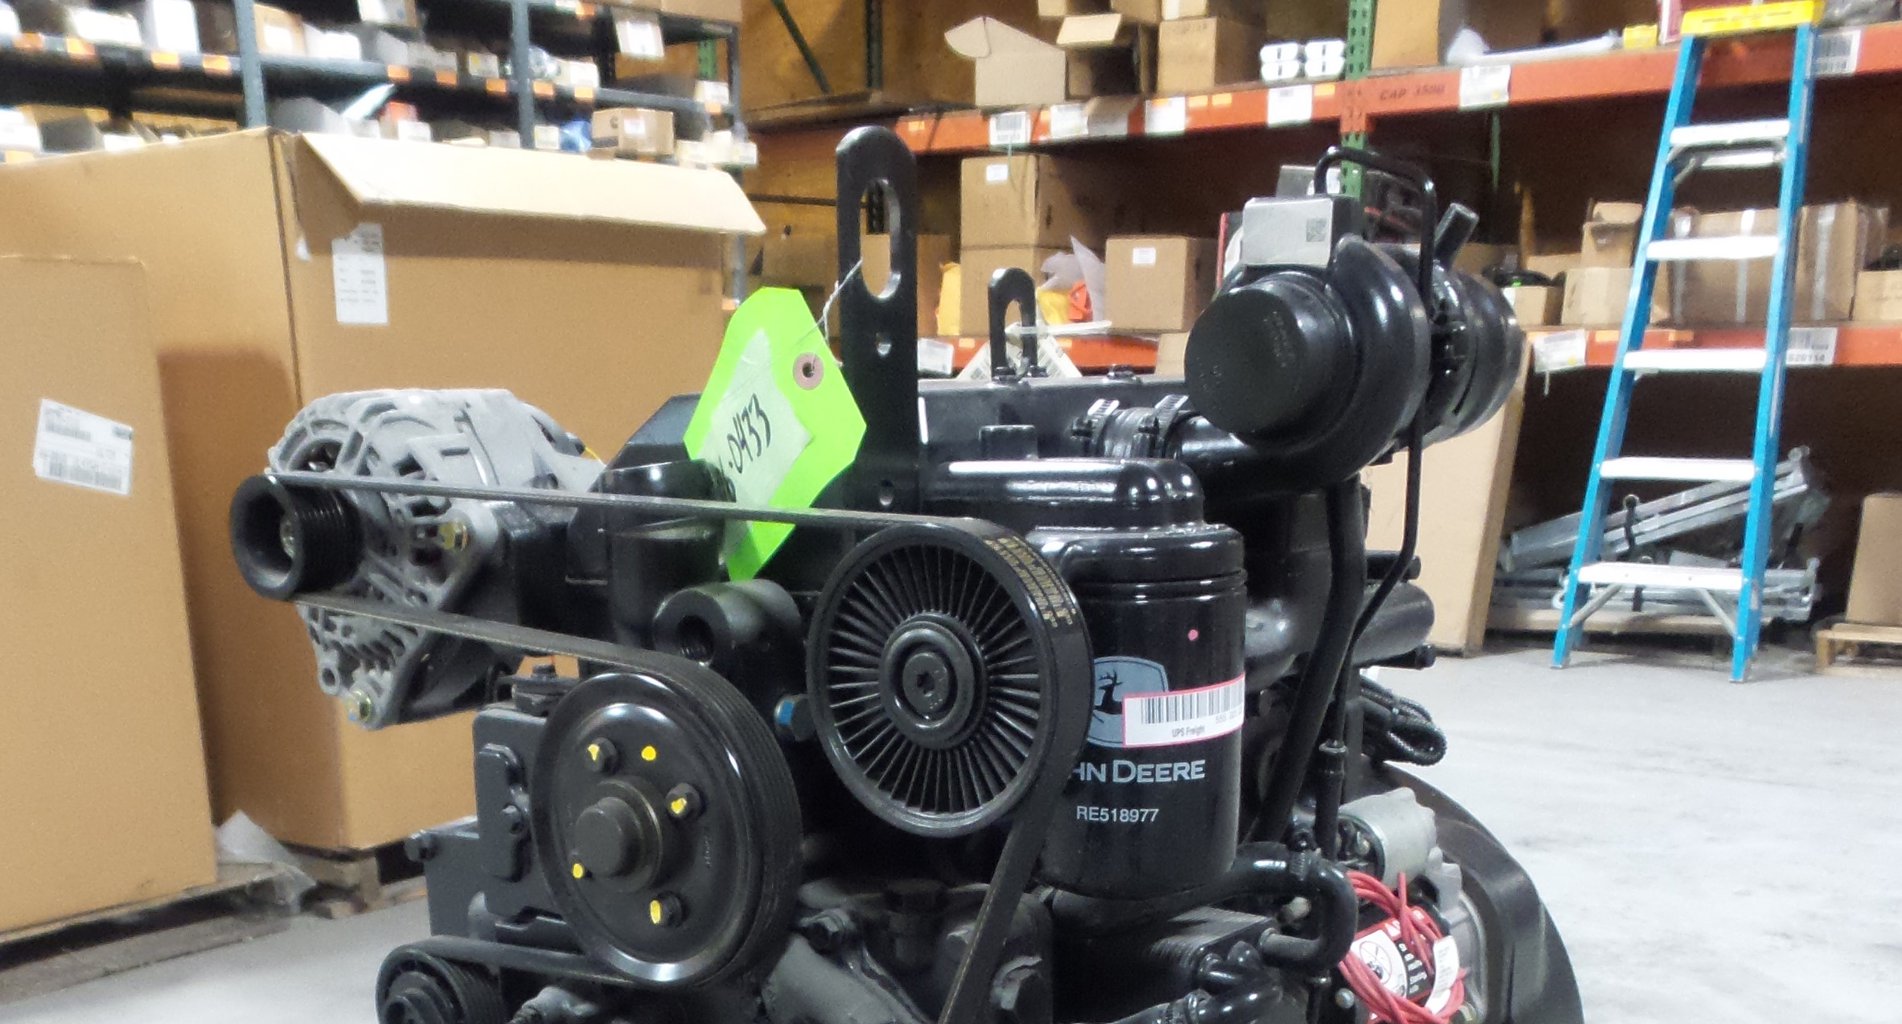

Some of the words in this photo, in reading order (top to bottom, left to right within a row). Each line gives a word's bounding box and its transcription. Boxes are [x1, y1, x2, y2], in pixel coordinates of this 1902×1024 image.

[1171, 727, 1185, 738] UPS
[1073, 761, 1107, 782] HN
[1112, 759, 1206, 783] DEERE
[1076, 805, 1160, 823] RE518977
